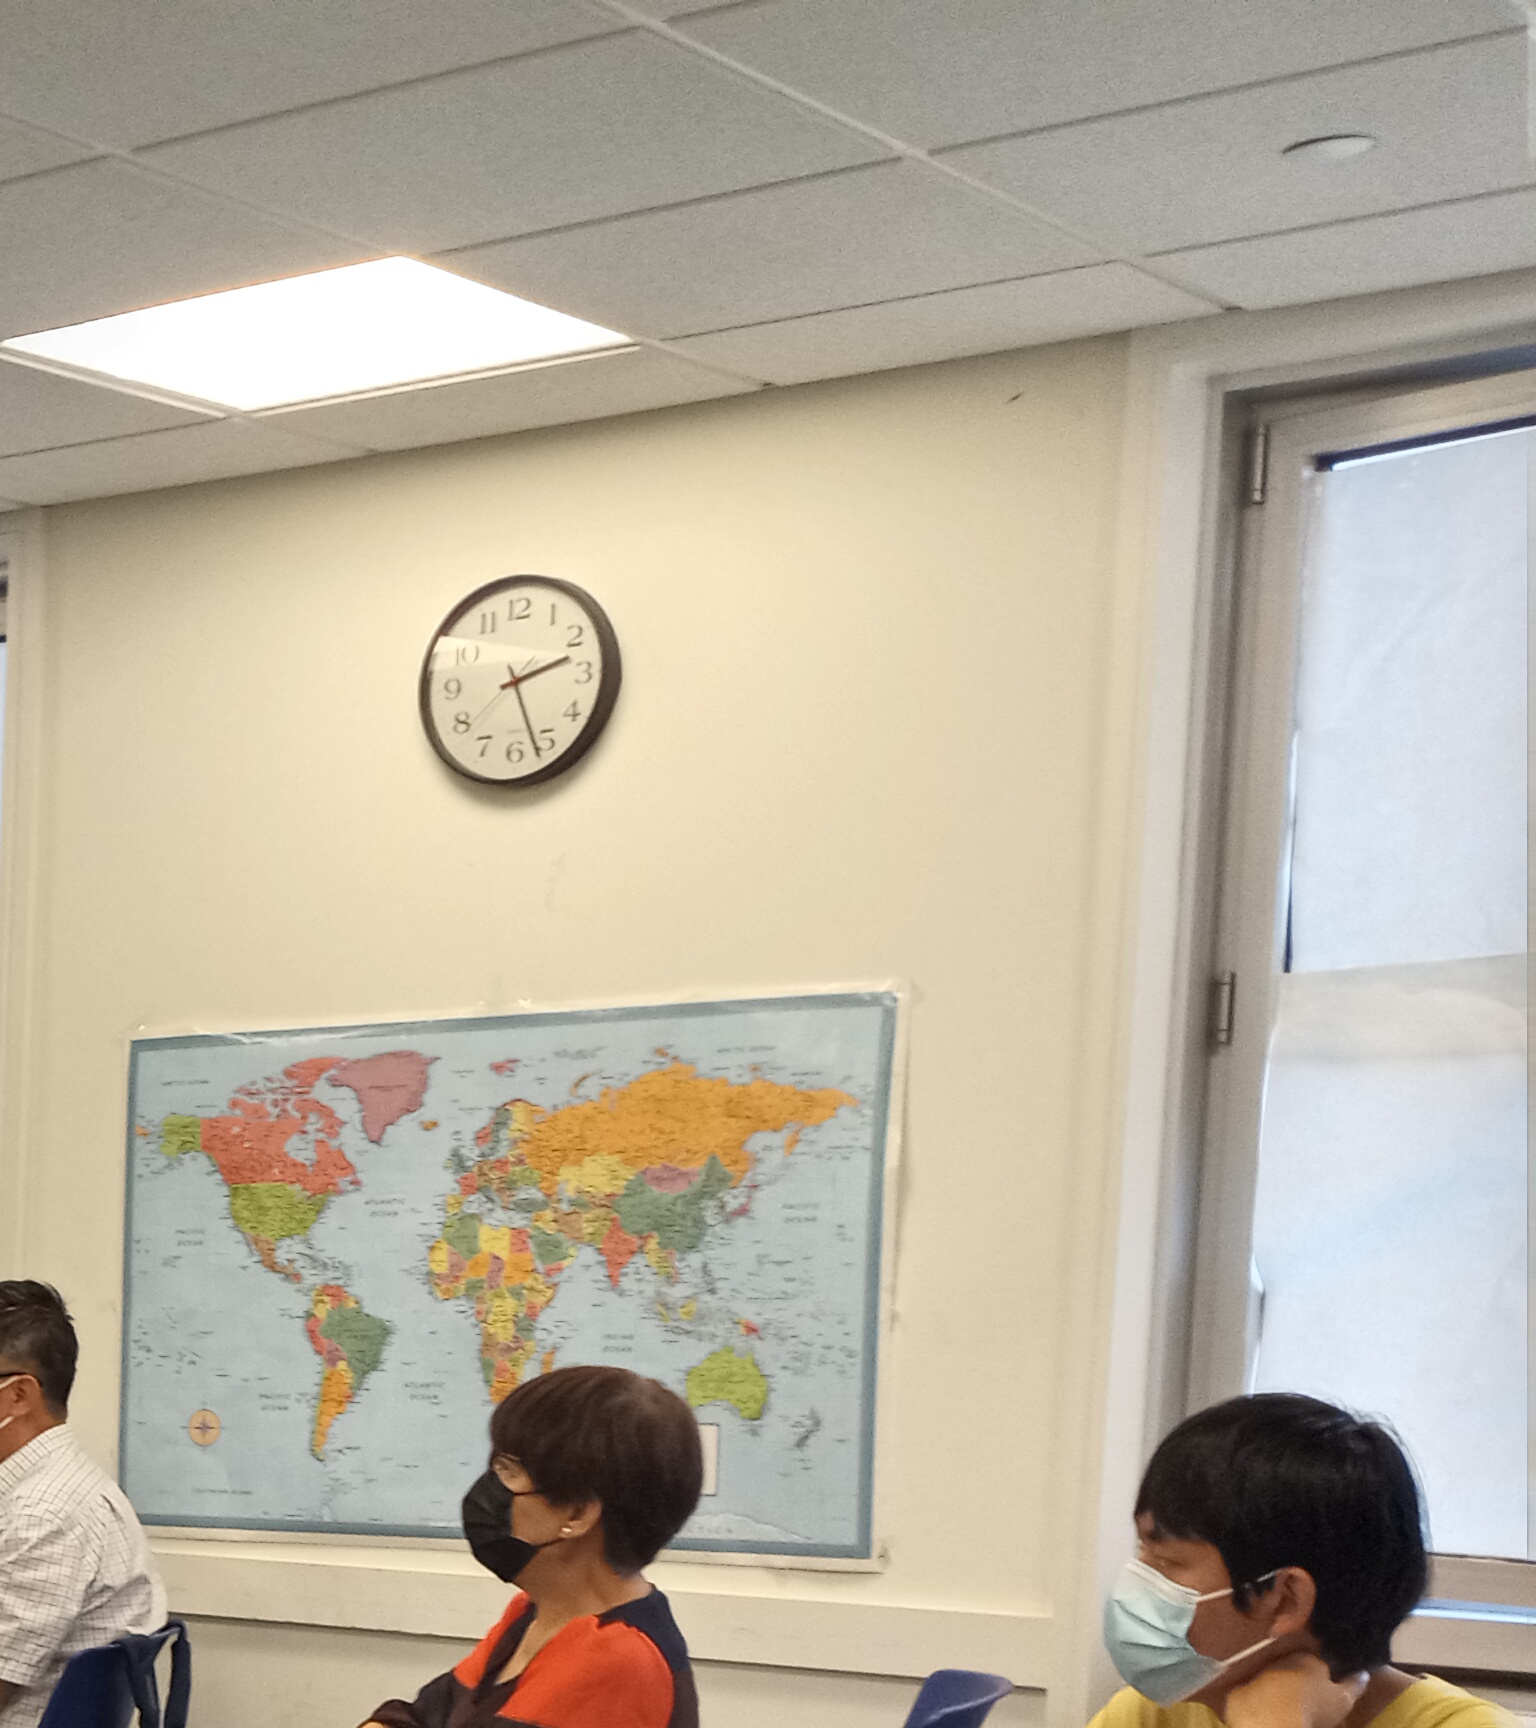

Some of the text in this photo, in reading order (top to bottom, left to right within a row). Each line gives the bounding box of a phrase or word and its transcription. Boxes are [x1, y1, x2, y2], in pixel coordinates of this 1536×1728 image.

[507, 597, 531, 621] 12
[549, 603, 556, 626] 1
[479, 611, 497, 635] 11
[566, 624, 584, 648] 2
[455, 645, 479, 666] 10
[574, 661, 593, 684] 3
[443, 678, 462, 701] 9
[453, 711, 471, 734] 8
[563, 700, 581, 722] 4
[476, 735, 493, 758] 7
[539, 728, 555, 751] 5
[505, 741, 524, 763] 6
